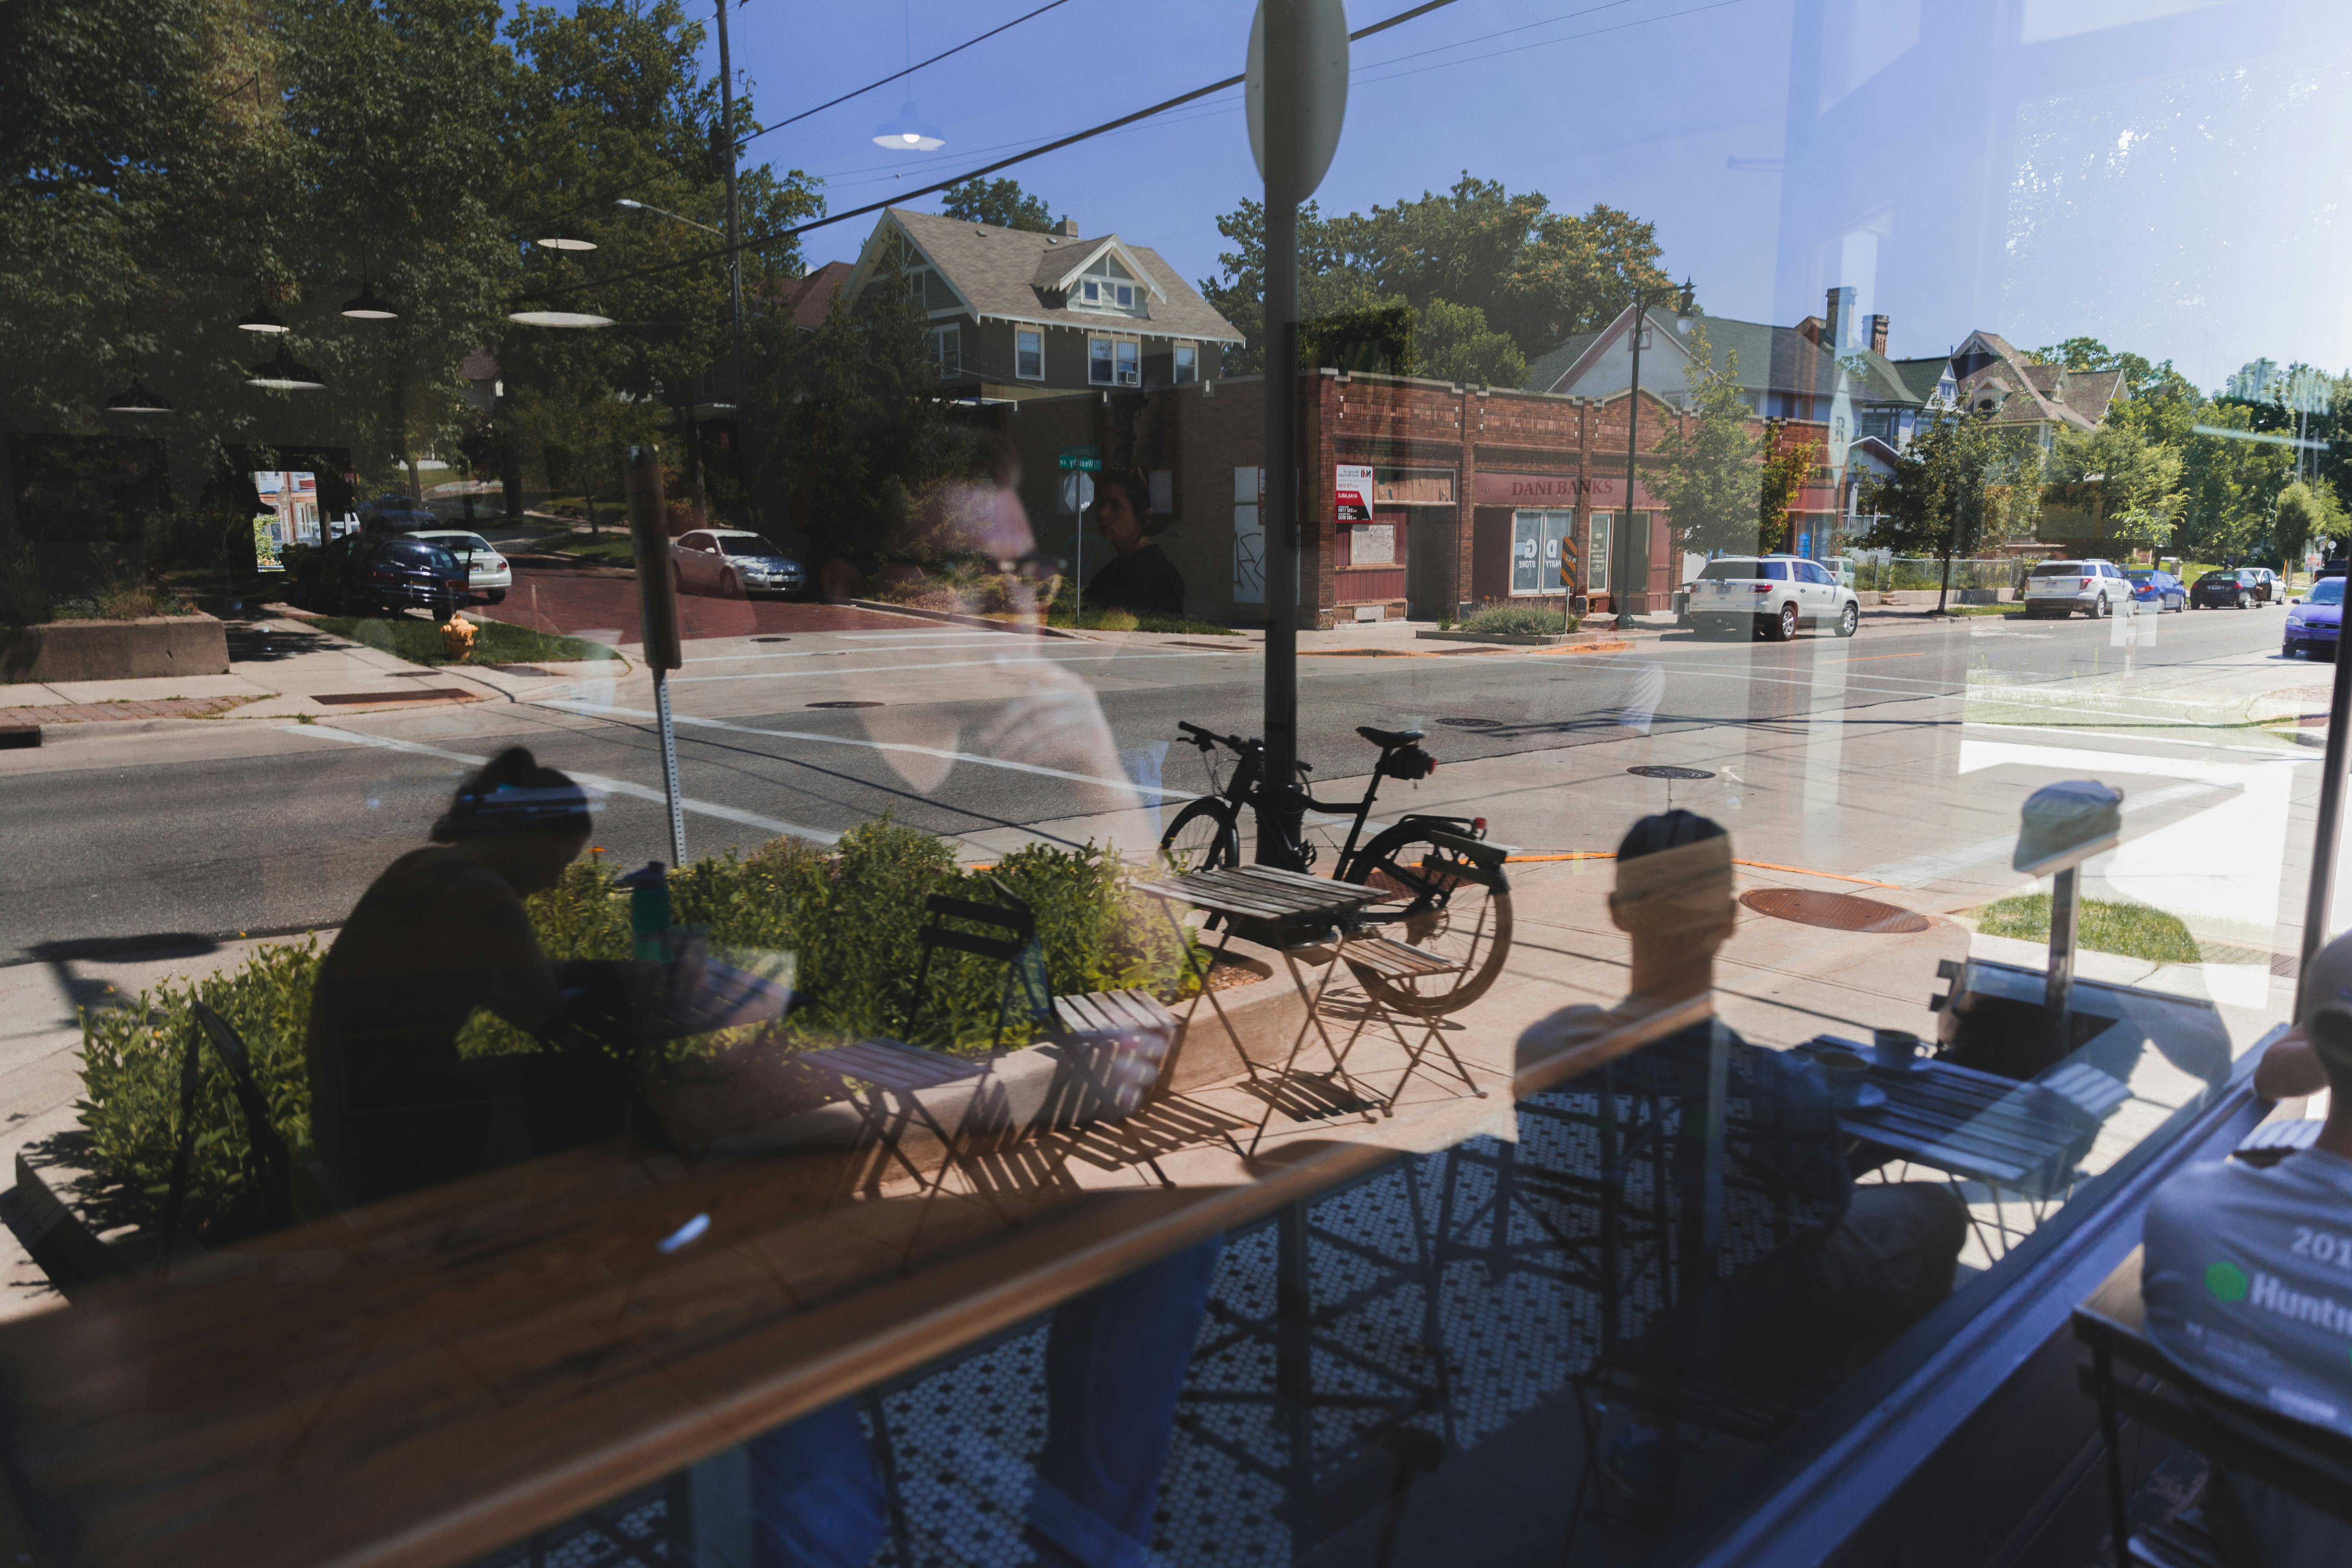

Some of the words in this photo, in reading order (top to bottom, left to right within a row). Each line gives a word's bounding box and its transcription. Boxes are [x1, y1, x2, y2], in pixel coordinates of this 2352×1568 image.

[1834, 416, 1845, 443] R
[1512, 481, 1552, 495] DANI
[1557, 479, 1613, 495] BANKS
